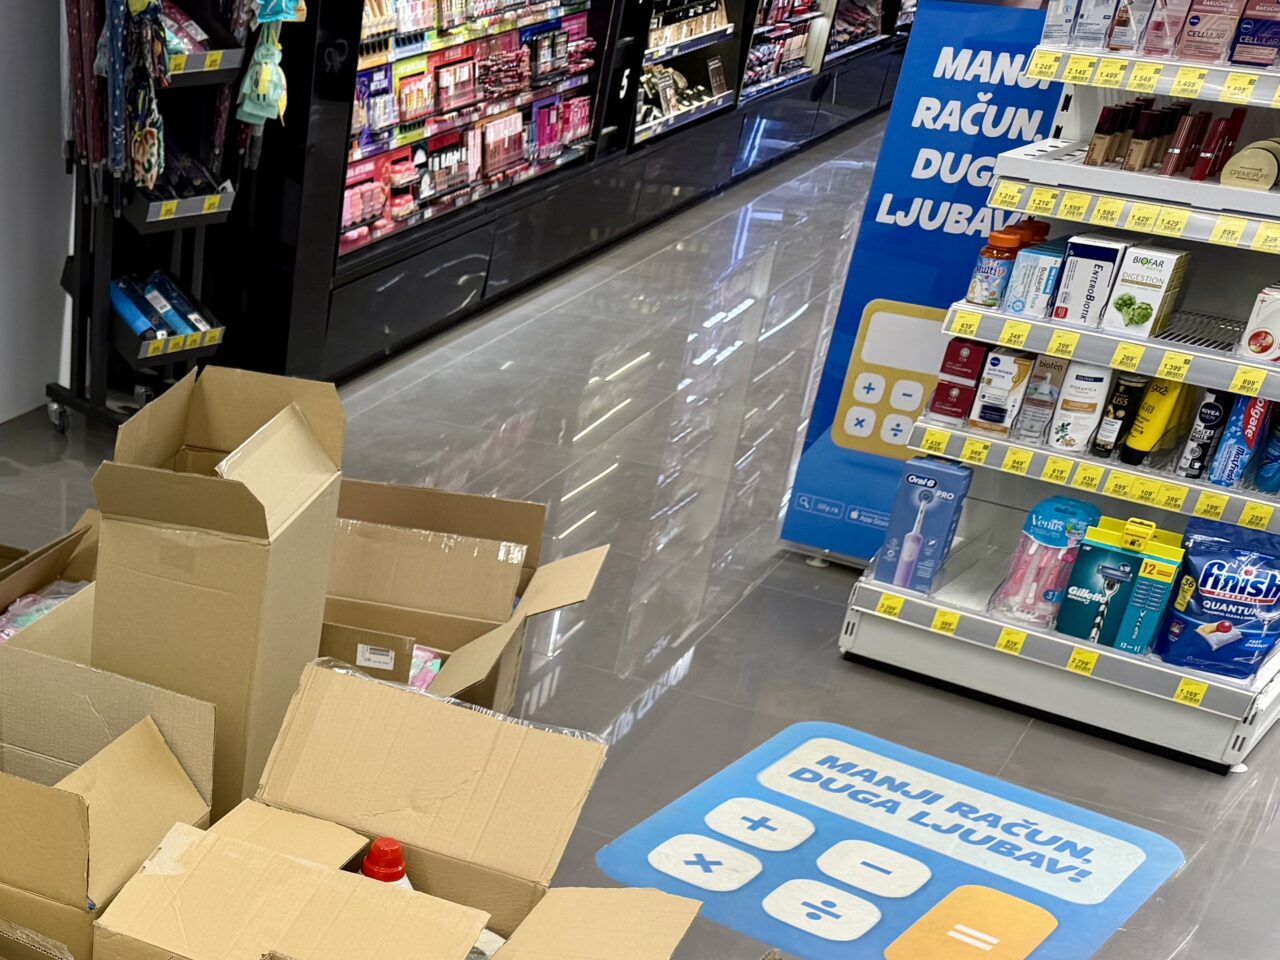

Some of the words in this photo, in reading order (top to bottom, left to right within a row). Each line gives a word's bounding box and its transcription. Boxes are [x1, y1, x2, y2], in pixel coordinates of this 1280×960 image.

[933, 46, 1052, 90] MAN
[911, 92, 1044, 143] RAČUN.
[911, 148, 999, 188] DUG
[1122, 271, 1165, 285] DIGESTION
[1132, 255, 1165, 269] BIOFAR
[1245, 398, 1269, 438] olgate
[936, 490, 955, 501] PRO
[1142, 562, 1155, 576] 12
[1182, 577, 1195, 589] 36
[788, 766, 902, 815] DUGA
[907, 811, 1094, 883] LJUBAV!
[815, 755, 945, 805] MANJI
[944, 801, 1095, 865] RAČUN,
